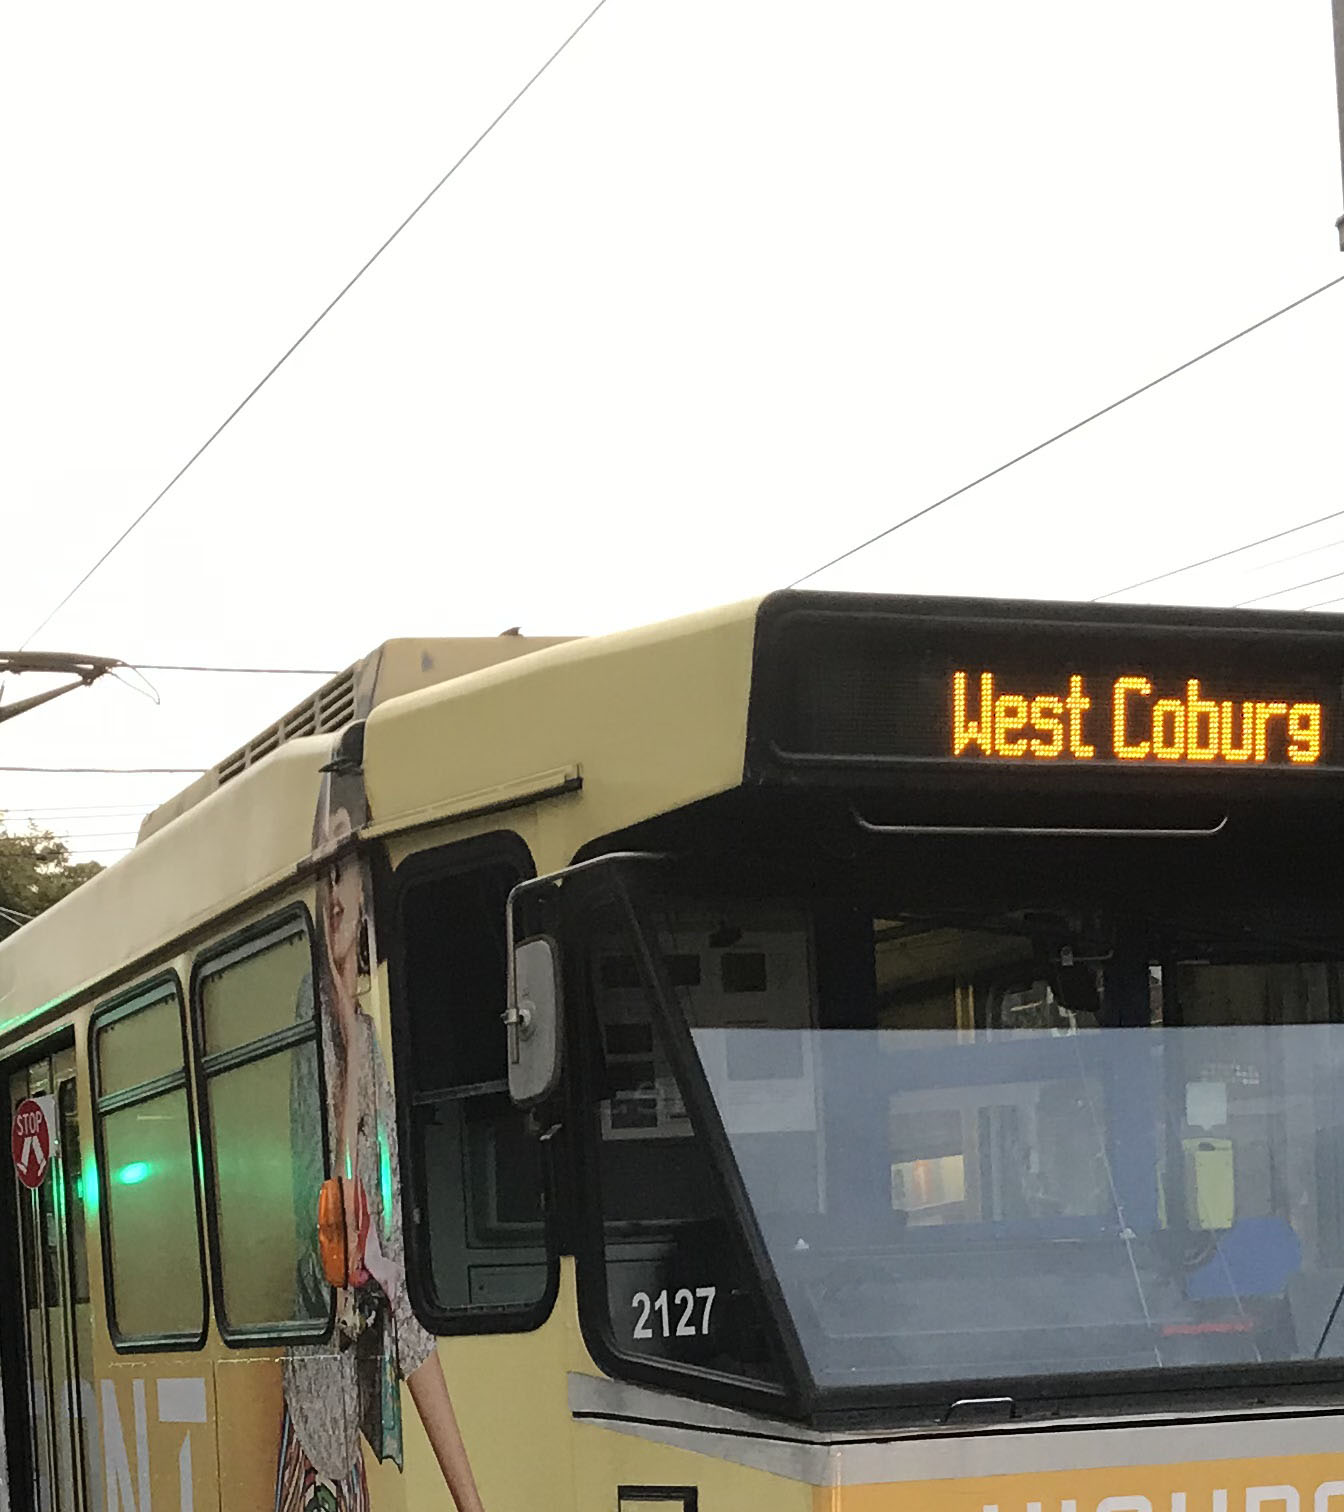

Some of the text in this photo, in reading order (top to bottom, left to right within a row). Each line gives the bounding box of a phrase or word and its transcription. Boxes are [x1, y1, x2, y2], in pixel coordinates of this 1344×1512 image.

[953, 671, 1095, 758] West
[1112, 676, 1322, 764] Coburg
[16, 1110, 43, 1136] STOP
[632, 1286, 716, 1339] 2127
